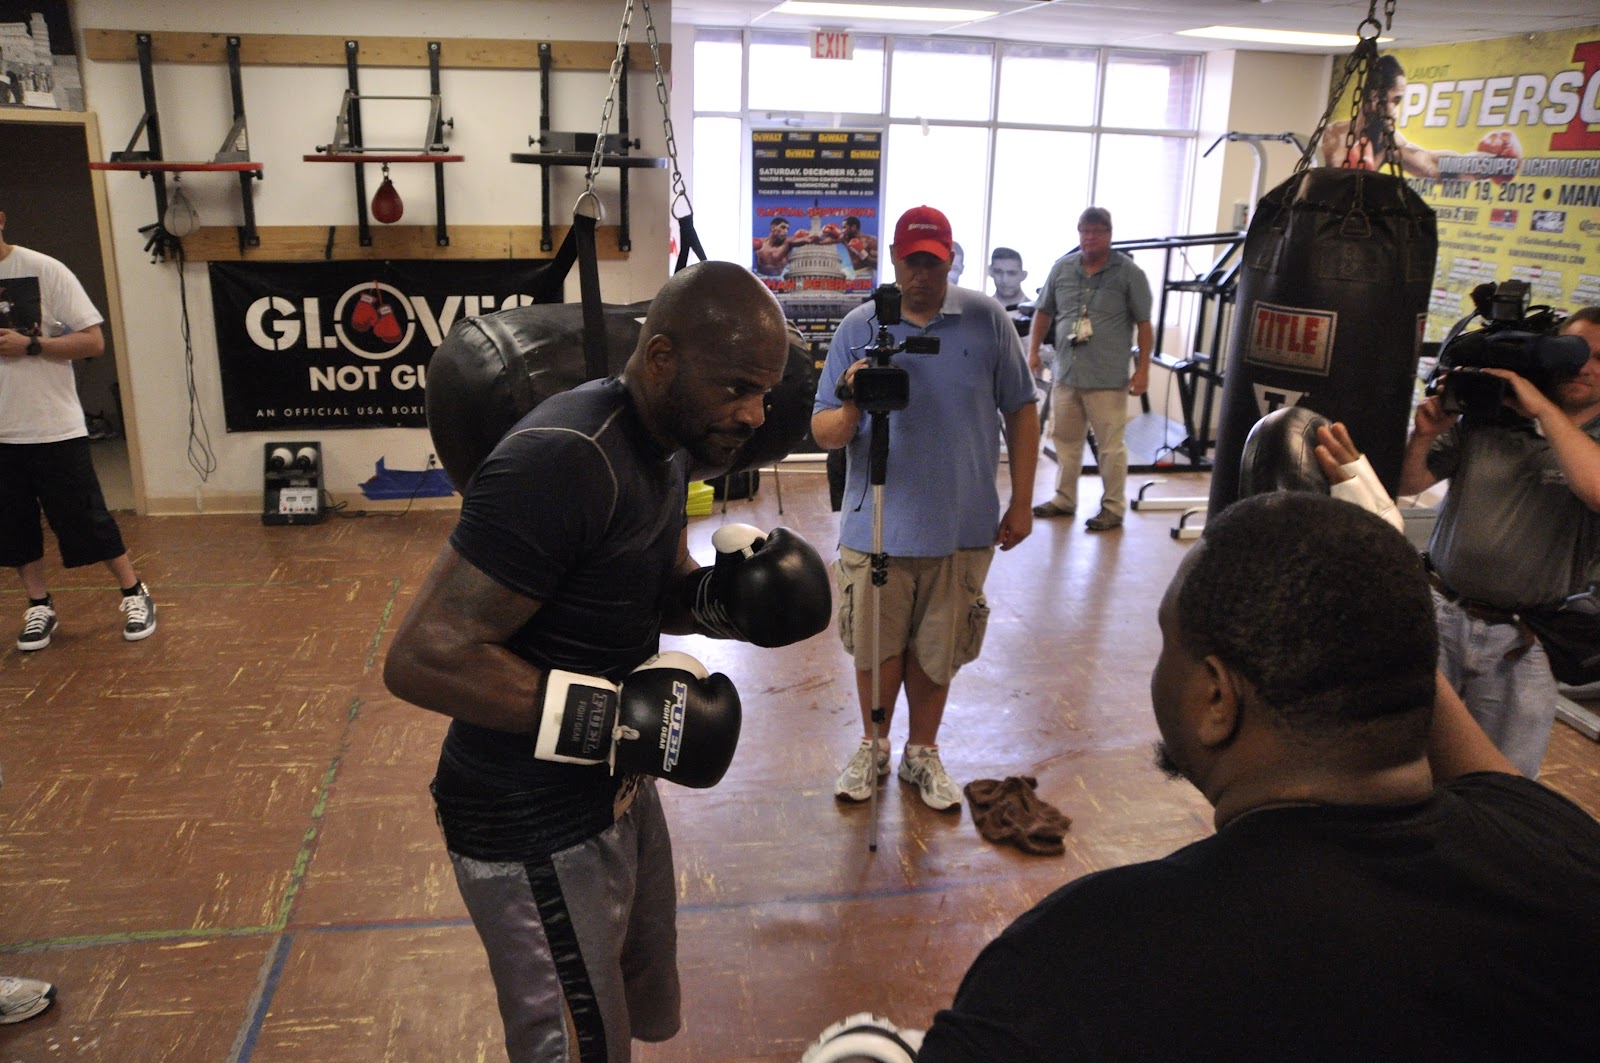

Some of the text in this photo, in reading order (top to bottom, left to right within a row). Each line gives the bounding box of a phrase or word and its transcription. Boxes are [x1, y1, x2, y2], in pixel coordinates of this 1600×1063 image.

[815, 32, 849, 59] EXIT
[1407, 64, 1451, 80] LAMONT
[759, 168, 801, 176] SATURDAY,
[803, 168, 845, 176] DECEMBER
[1480, 157, 1518, 176] SUPER
[1441, 179, 1471, 200] MAY
[1475, 182, 1494, 204] 19,
[1499, 183, 1536, 204] 2012
[757, 207, 875, 217] CAPITAL SHOWDOWN
[803, 278, 872, 290] PETERSON
[1256, 309, 1320, 355] TITLE
[309, 366, 381, 391] NOT
[256, 405, 424, 418] AN OFFICIAL USA BOXI
[658, 699, 672, 750] FIGHT GEAR
[663, 680, 688, 773] FUEL
